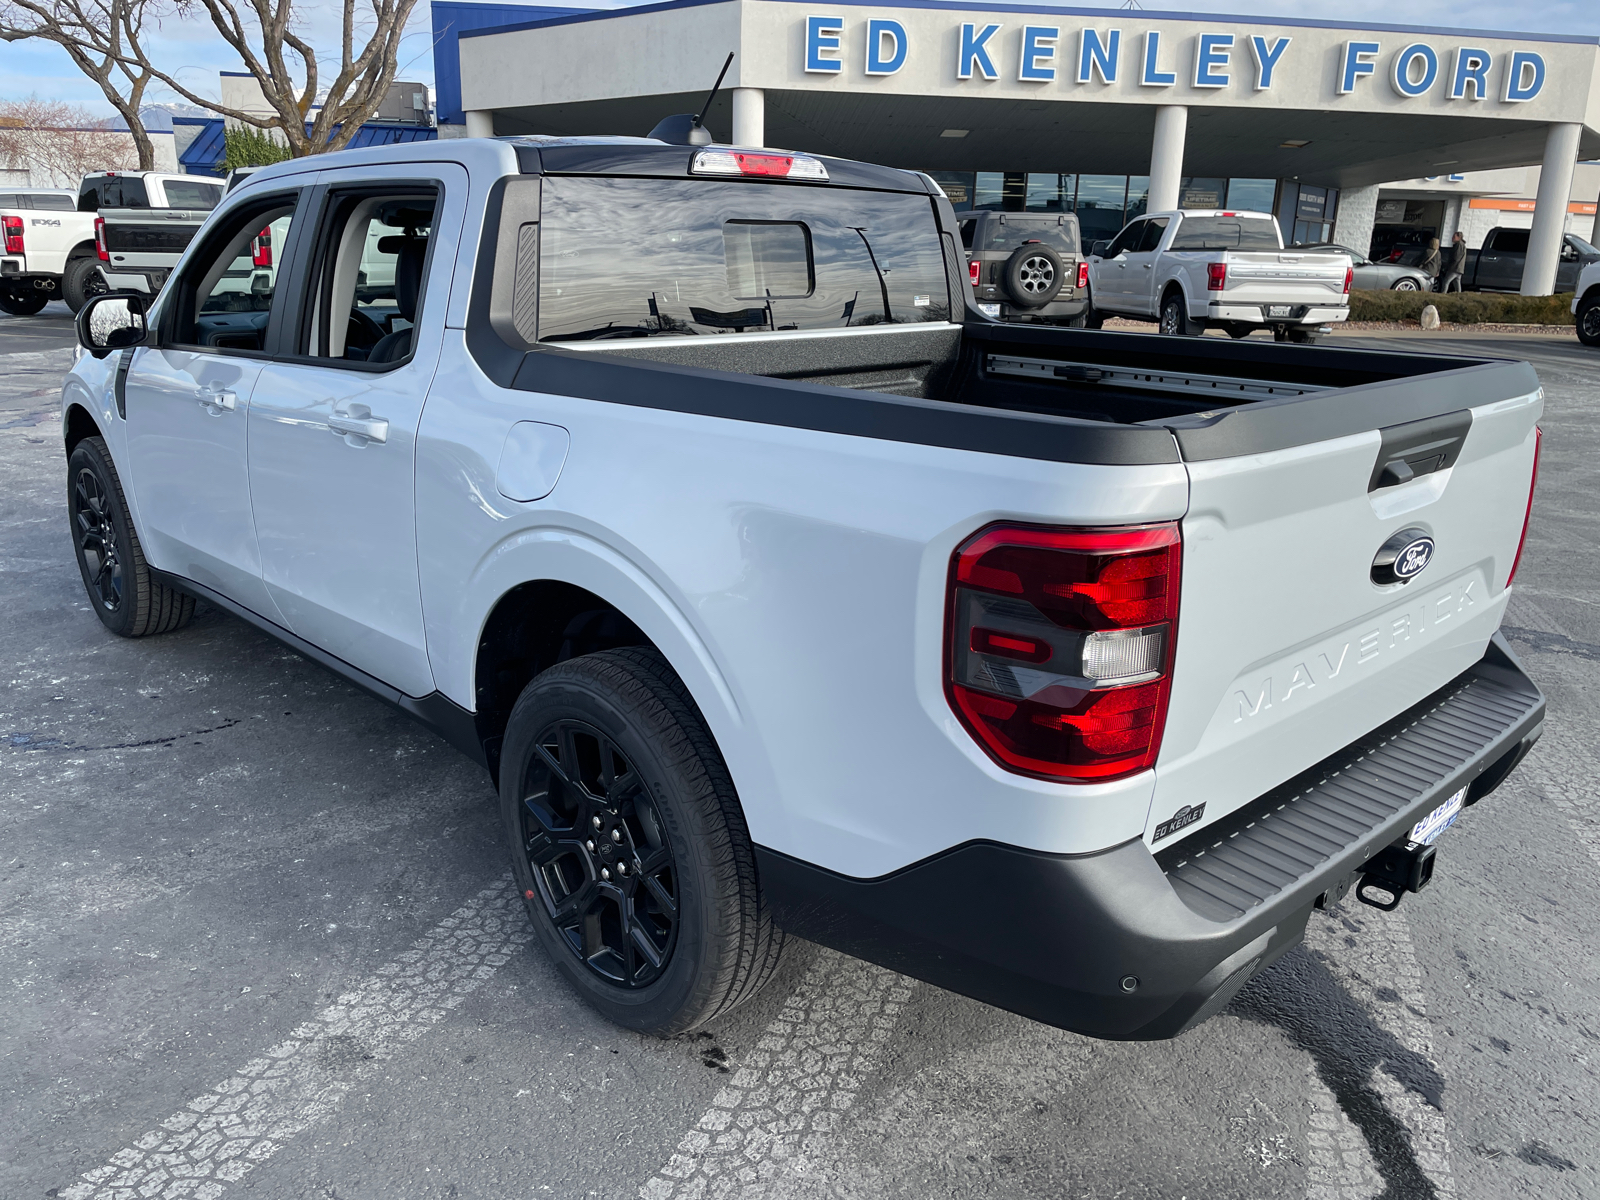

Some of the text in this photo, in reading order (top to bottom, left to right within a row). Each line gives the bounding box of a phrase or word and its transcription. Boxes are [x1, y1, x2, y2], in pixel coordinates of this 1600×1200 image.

[804, 15, 1548, 103] ED KENLEY FORD
[31, 219, 61, 227] FX4
[1402, 544, 1429, 574] Ford
[1233, 579, 1476, 723] MAVERICK
[1155, 825, 1168, 840] ED
[1169, 807, 1206, 833] KENLEY
